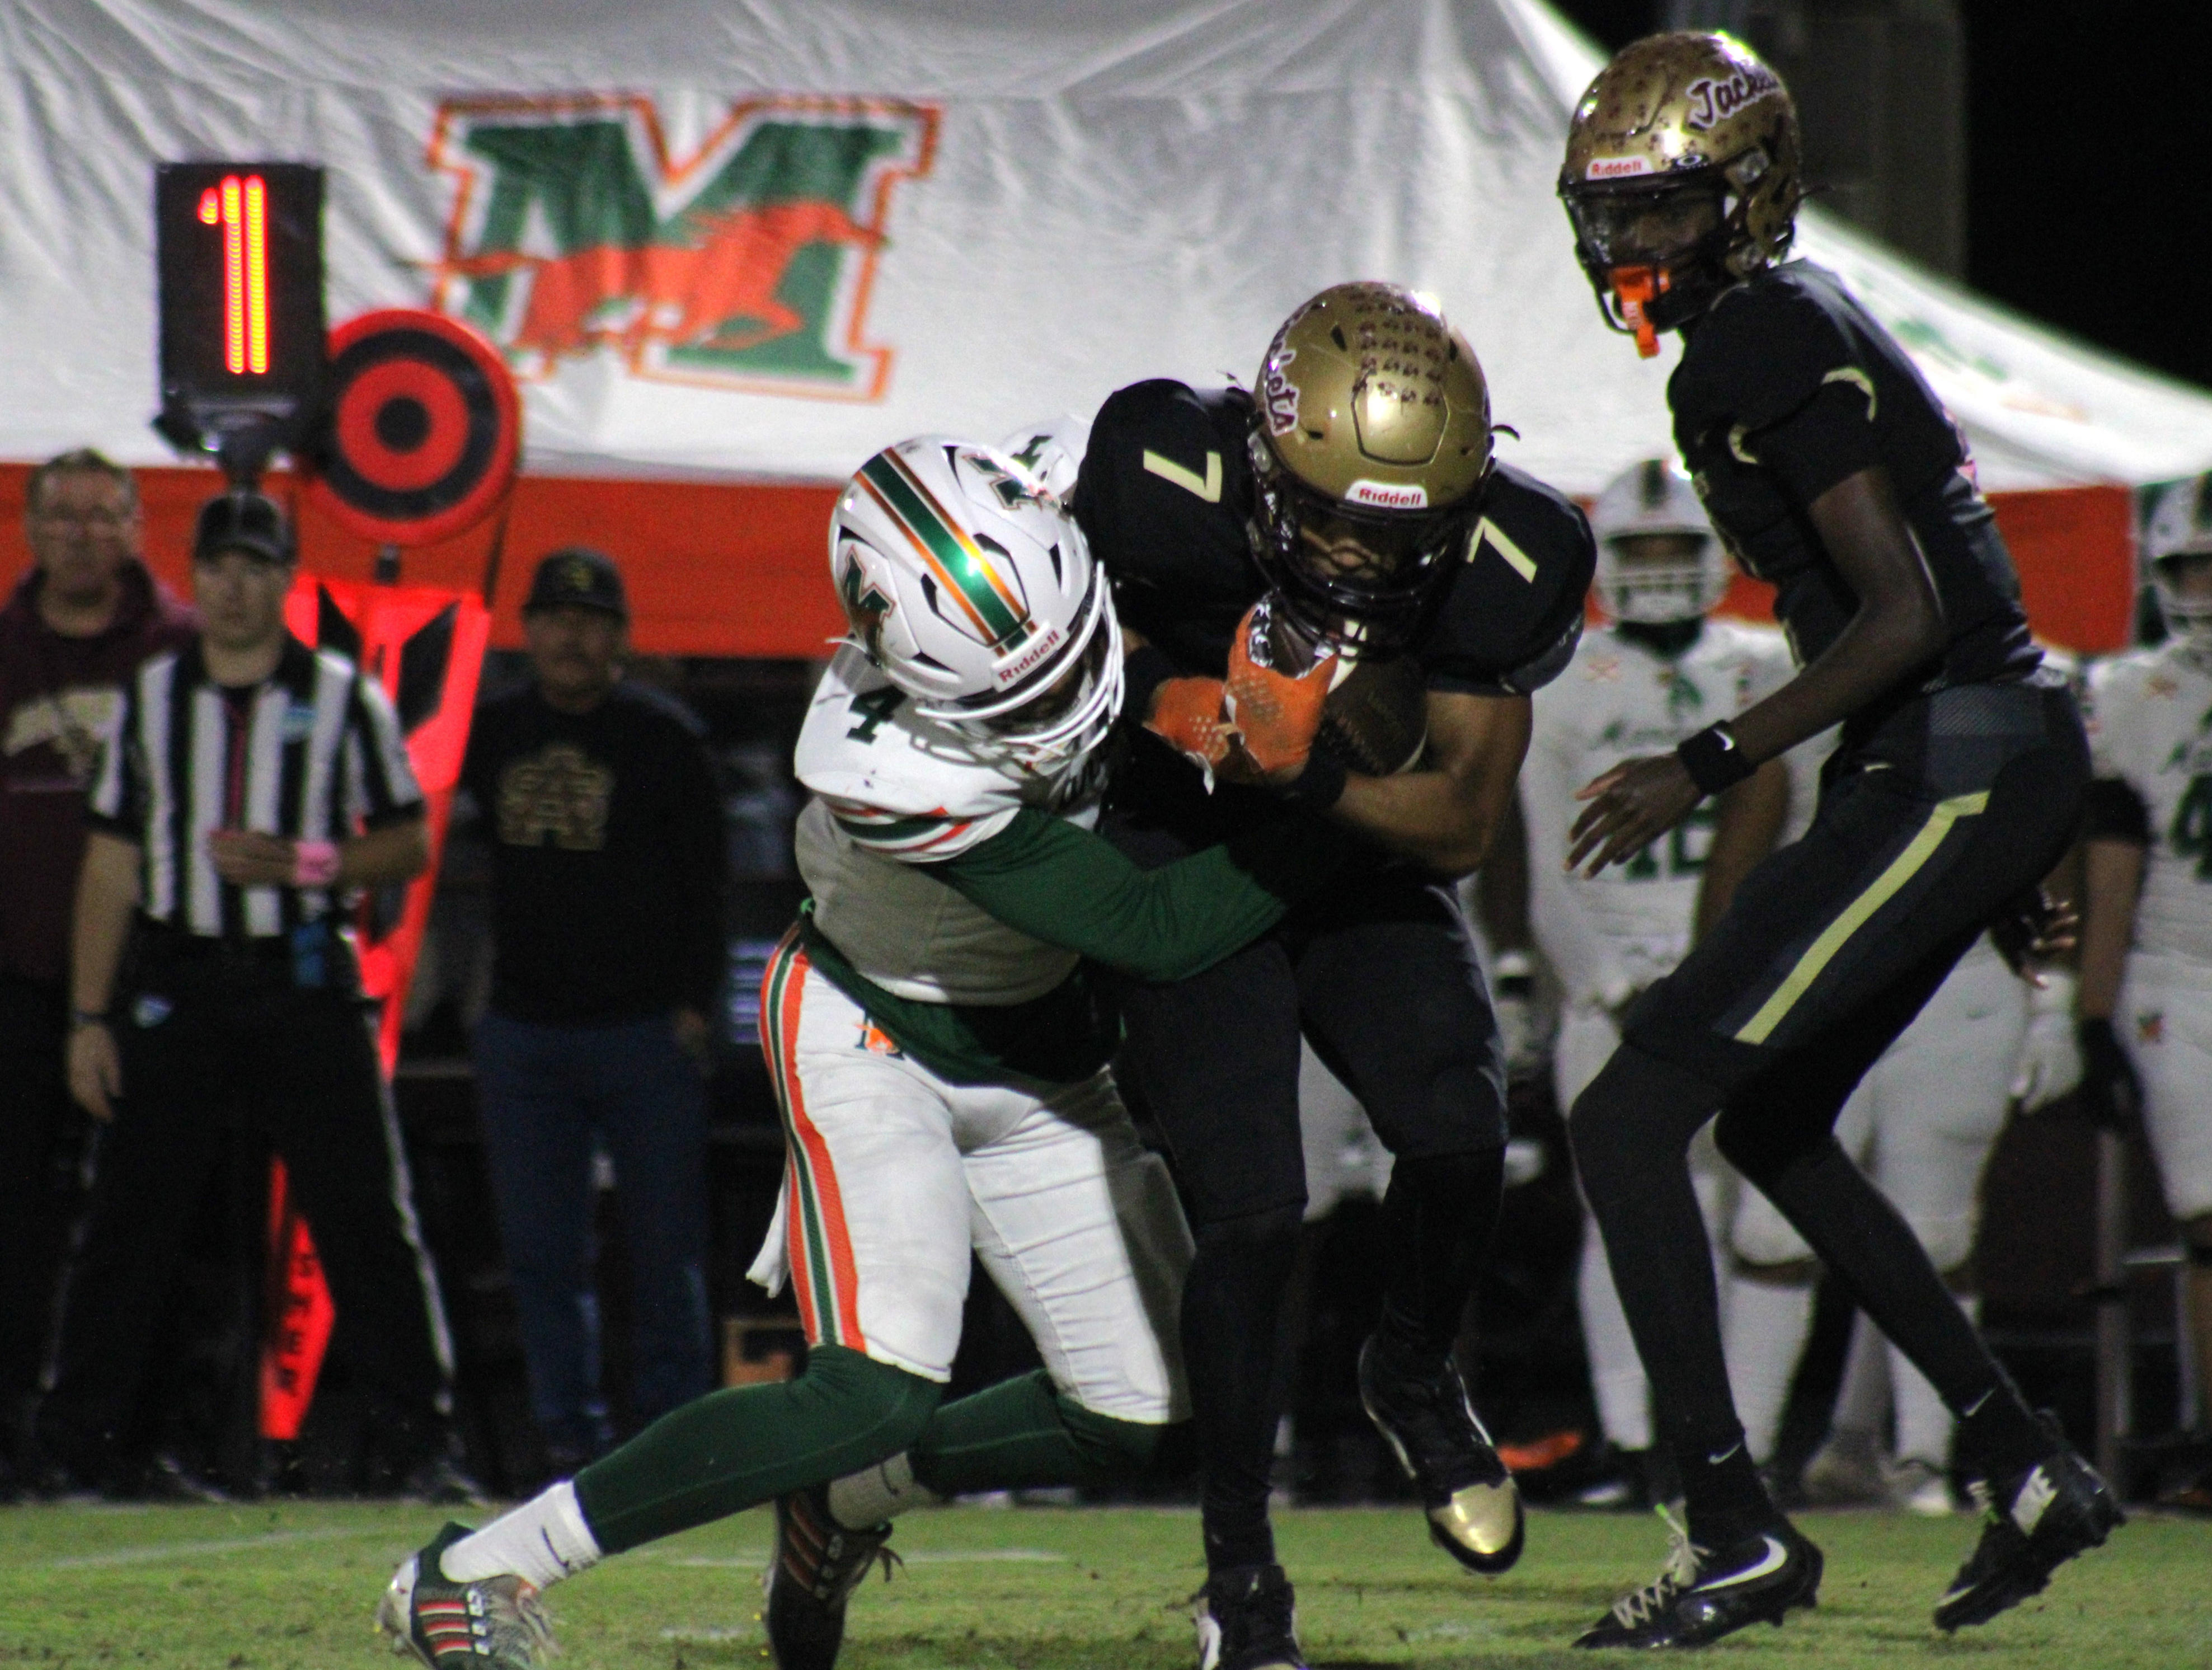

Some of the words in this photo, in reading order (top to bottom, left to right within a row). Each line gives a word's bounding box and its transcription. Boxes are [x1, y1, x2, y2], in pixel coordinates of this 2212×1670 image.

[1591, 159, 1642, 176] Riddell
[198, 175, 270, 374] 1
[428, 93, 941, 402] M
[1143, 448, 1222, 504] 7
[1359, 488, 1421, 506] Riddell
[1465, 516, 1538, 584] 7
[998, 629, 1060, 683] Riddell
[845, 685, 908, 744] 4
